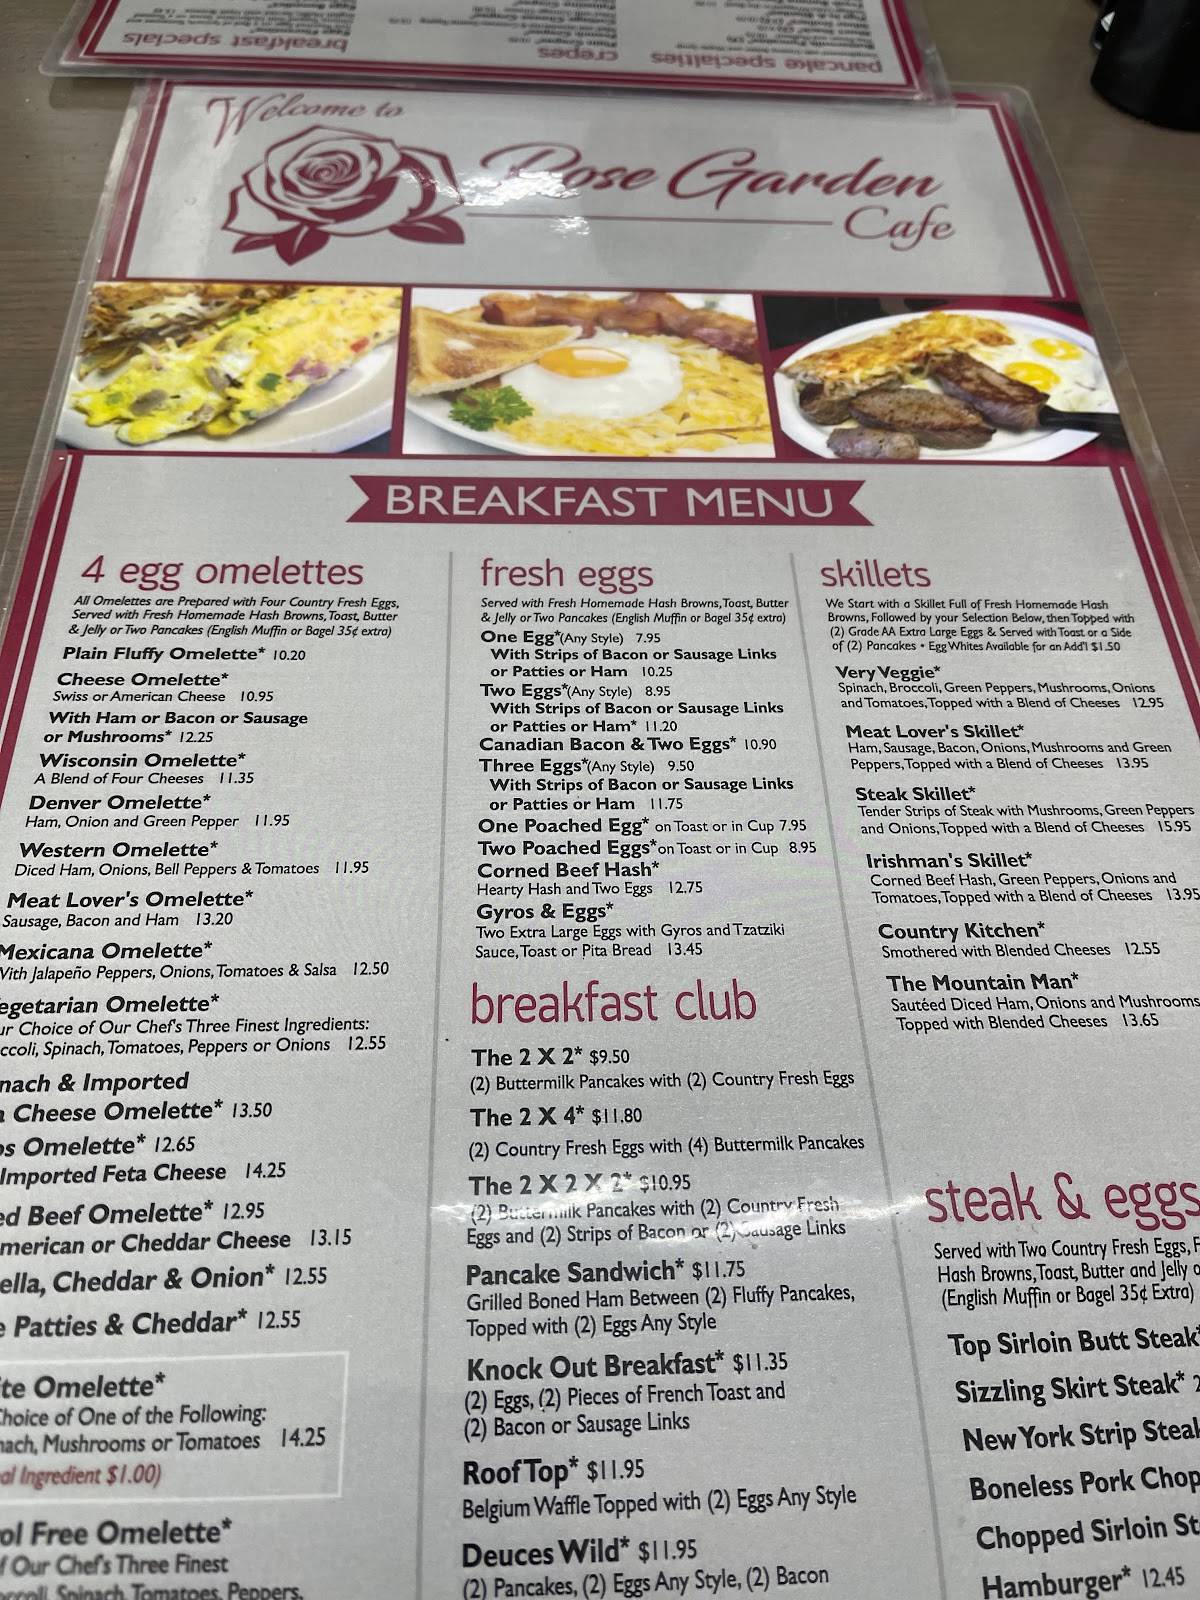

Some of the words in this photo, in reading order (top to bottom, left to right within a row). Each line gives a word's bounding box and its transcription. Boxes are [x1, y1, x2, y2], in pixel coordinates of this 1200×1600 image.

[206, 93, 366, 148] Welcome
[375, 101, 404, 119] to
[667, 147, 944, 210] Garden
[843, 204, 956, 252] Cafe
[385, 484, 668, 517] BREAKFAST
[686, 487, 834, 519] MENU
[81, 555, 104, 583] 4
[120, 563, 183, 591] egg
[196, 556, 363, 585] omelettes
[481, 558, 563, 586] fresh
[579, 566, 653, 594] eggs
[821, 559, 931, 587] skillets
[74, 596, 91, 605] All
[94, 596, 151, 605] Omelettes
[178, 596, 230, 608] Prepared
[233, 597, 256, 606] with
[260, 597, 286, 606] Four
[290, 597, 334, 609] Country
[338, 597, 366, 607] Fresh
[371, 598, 399, 610] Eggs,
[825, 599, 843, 608] We
[848, 599, 874, 608] Start
[878, 599, 899, 608] with
[915, 599, 945, 608] Skillet
[949, 599, 966, 608] Full
[971, 599, 982, 610] of
[985, 599, 1011, 608] Fresh
[1016, 600, 1077, 609] Homemade
[1081, 600, 1108, 609] Hash
[63, 647, 107, 659] Plain
[114, 647, 164, 663] Fluffy
[274, 650, 305, 660] 10.20
[491, 649, 529, 659] With
[535, 649, 578, 663] Strips
[583, 649, 598, 659] of
[603, 649, 647, 659] Bacon
[674, 649, 733, 662] Sausage
[738, 649, 776, 659] Links
[480, 738, 563, 750] Canadian
[570, 738, 624, 750] Bacon
[631, 737, 645, 750] &
[647, 737, 683, 750] Two
[745, 739, 776, 749] 10.90
[846, 725, 891, 738] Meat
[896, 725, 959, 738] Lover's
[40, 754, 137, 767] Wisconsin
[34, 773, 45, 784] A
[51, 773, 89, 784] Blend
[93, 773, 110, 784] of
[111, 773, 143, 784] Four
[148, 773, 203, 783] Cheeses
[220, 772, 254, 783] 11.35
[29, 796, 101, 809] Denver
[856, 787, 908, 800] Steak
[26, 816, 60, 828] Ham,
[66, 816, 108, 827] Onion
[114, 815, 138, 827] and
[144, 815, 186, 826] Green
[192, 815, 239, 830] Pepper
[256, 815, 289, 826] 11.95
[866, 853, 963, 868] Irishman's
[871, 874, 921, 886] Corned
[926, 874, 954, 885] Beef
[959, 874, 996, 886] Hash,
[999, 873, 1040, 885] Green
[1044, 873, 1099, 888] Peppers,
[1102, 872, 1149, 884] Onions
[1153, 872, 1176, 883] and
[477, 904, 534, 923] Gyros
[541, 903, 555, 918] &
[879, 924, 958, 943] Country
[882, 945, 957, 958] Smothered
[961, 945, 991, 957] with
[995, 944, 1050, 956] Blended
[1054, 943, 1110, 955] Cheeses
[1125, 942, 1160, 954] 12.55
[886, 976, 926, 991] The
[932, 974, 1025, 990] Mountain
[472, 980, 658, 1024] breakfast
[676, 979, 756, 1020] club
[471, 1076, 490, 1095] (2)
[497, 1075, 574, 1090] Buttermilk
[580, 1074, 644, 1088] Pancakes
[650, 1073, 681, 1087] with
[688, 1072, 706, 1090] (2)
[713, 1072, 774, 1089] Country
[779, 1071, 818, 1085] Fresh
[823, 1070, 854, 1088] Eggs
[470, 1109, 512, 1126] The
[520, 1108, 531, 1125] 2
[538, 1107, 557, 1125] X
[592, 1108, 642, 1125] $11.80
[0, 1166, 97, 1190] Imported
[103, 1165, 147, 1182] Feta
[154, 1164, 226, 1181] Cheese
[246, 1162, 285, 1178] 14.25
[926, 1172, 1042, 1222] steak
[1054, 1172, 1090, 1219] &
[1105, 1182, 1200, 1231] eggs
[467, 1263, 560, 1285] Pancake
[692, 1261, 745, 1280] $11.75
[467, 1293, 522, 1311] Grilled
[529, 1291, 579, 1309] Boned
[586, 1290, 623, 1307] Ham
[630, 1289, 698, 1306] Between
[706, 1287, 726, 1309] (2)
[733, 1285, 774, 1307] Fluffy
[780, 1284, 854, 1302] Pancakes,
[942, 1288, 997, 1311] (English
[1004, 1287, 1050, 1308] Muffin
[1057, 1291, 1070, 1303] or
[1076, 1285, 1114, 1307] Bagel
[1152, 1282, 1193, 1303] Extra)
[14, 1315, 97, 1337] Patties
[105, 1313, 124, 1335] &
[259, 1310, 300, 1329] 12.55
[947, 1334, 991, 1362] Top
[998, 1331, 1072, 1354] Sirloin
[1078, 1330, 1130, 1351] Butt
[468, 1357, 543, 1381] Knock
[550, 1356, 598, 1378] Out
[733, 1352, 787, 1374] $11.35
[956, 1379, 1046, 1407] Sizzling
[1051, 1376, 1109, 1399] Skirt
[20, 1466, 101, 1490] Ingredient
[106, 1464, 161, 1488] $1.00)
[462, 1542, 554, 1568] Deuces
[639, 1539, 697, 1563] $11.95
[1143, 1566, 1184, 1587] 12.45
